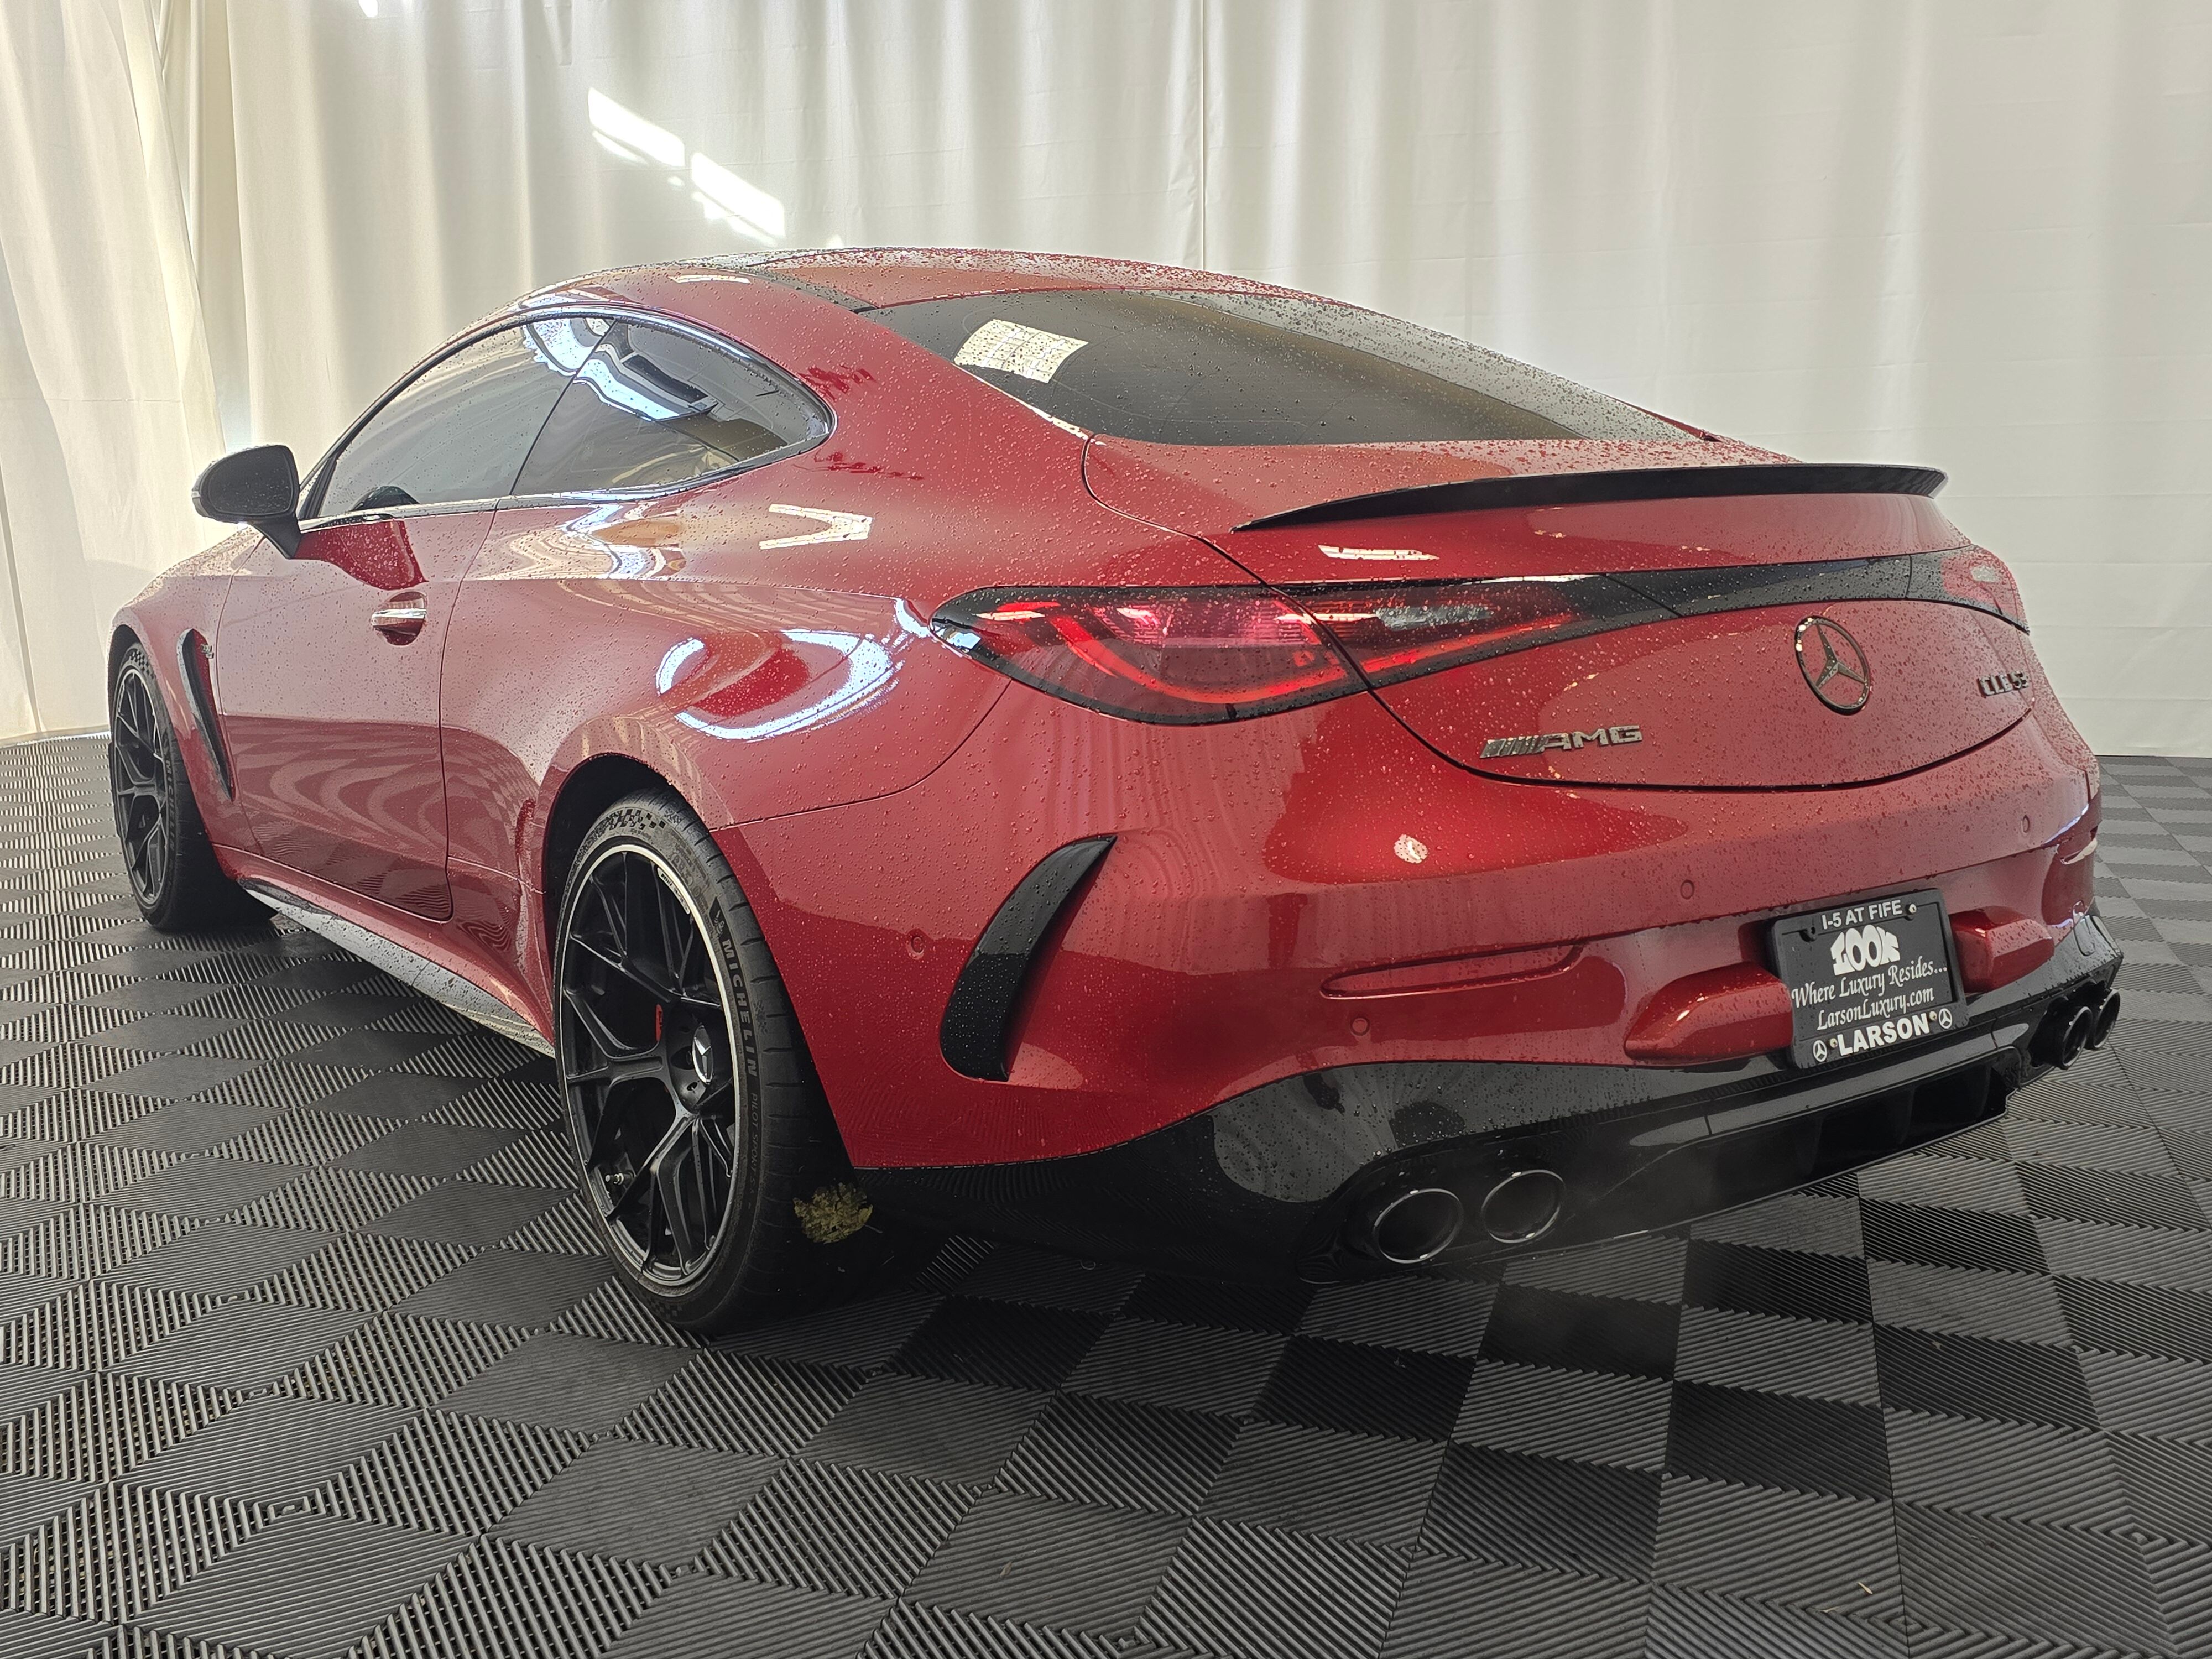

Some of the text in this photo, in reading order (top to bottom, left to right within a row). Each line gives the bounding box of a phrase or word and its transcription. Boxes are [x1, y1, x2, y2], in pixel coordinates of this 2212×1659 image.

[1541, 725, 1643, 750] AMG
[166, 760, 175, 851] MICHELIN
[1822, 899, 1903, 930] I-5 AT FIFE
[1791, 956, 1948, 1008] Where Luxury Resides...
[722, 938, 757, 1076] MICHELIN
[1817, 987, 1935, 1030] LarsonLuxury.com
[1837, 1013, 1930, 1056] LARSON
